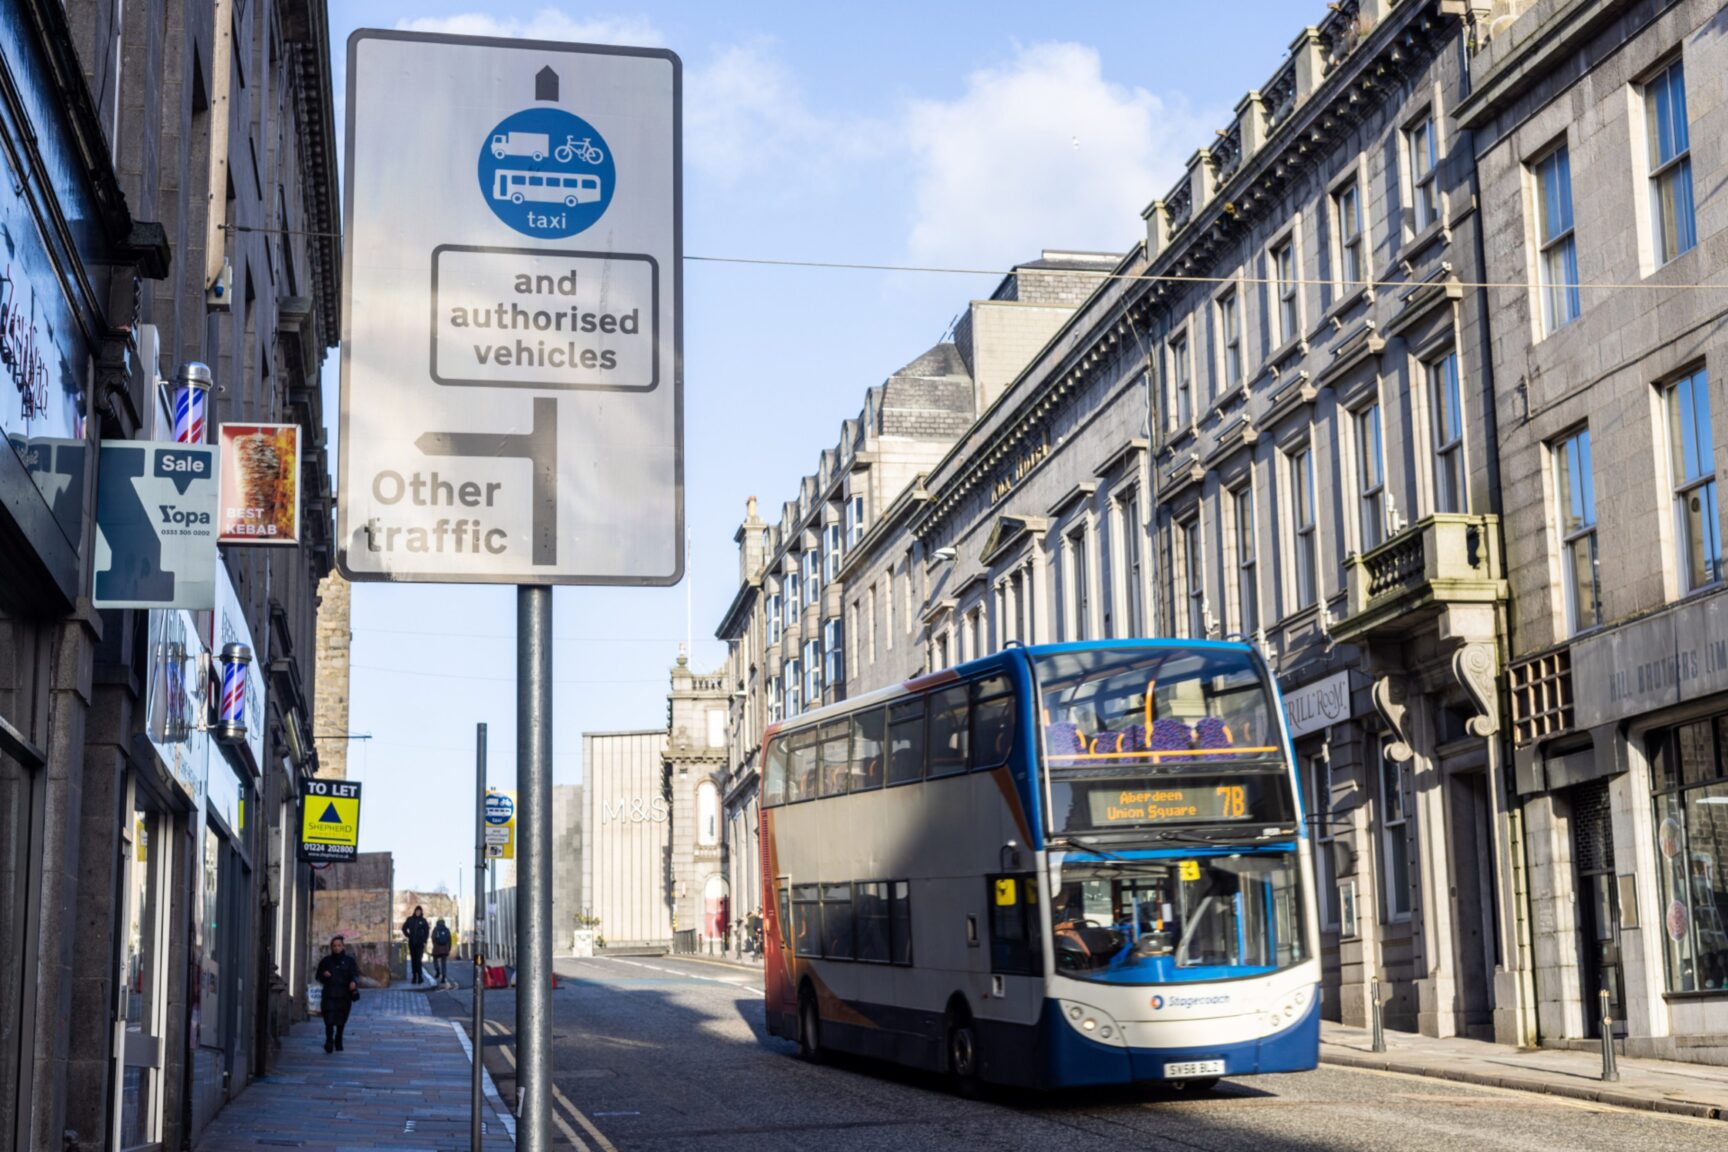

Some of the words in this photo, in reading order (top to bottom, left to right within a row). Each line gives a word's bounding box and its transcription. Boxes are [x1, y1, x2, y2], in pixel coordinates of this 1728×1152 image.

[527, 211, 567, 230] taxi
[514, 269, 577, 296] and
[450, 302, 640, 335] authorised
[473, 339, 618, 370] vehicles
[161, 455, 204, 472] Sale
[372, 469, 502, 507] Other
[158, 505, 210, 527] Yopa
[226, 507, 265, 519] BEST
[226, 524, 277, 535] KEBAB
[364, 517, 508, 554] traffic
[1283, 694, 1315, 730] RILL
[307, 782, 327, 795] TO
[332, 784, 357, 797] LET
[1119, 790, 1184, 804] Aberdeen
[602, 795, 668, 825] M&S
[1106, 806, 1145, 820] Union
[1147, 804, 1197, 819] Square
[1216, 785, 1245, 817] 7B
[308, 822, 353, 833] SHEPHERD
